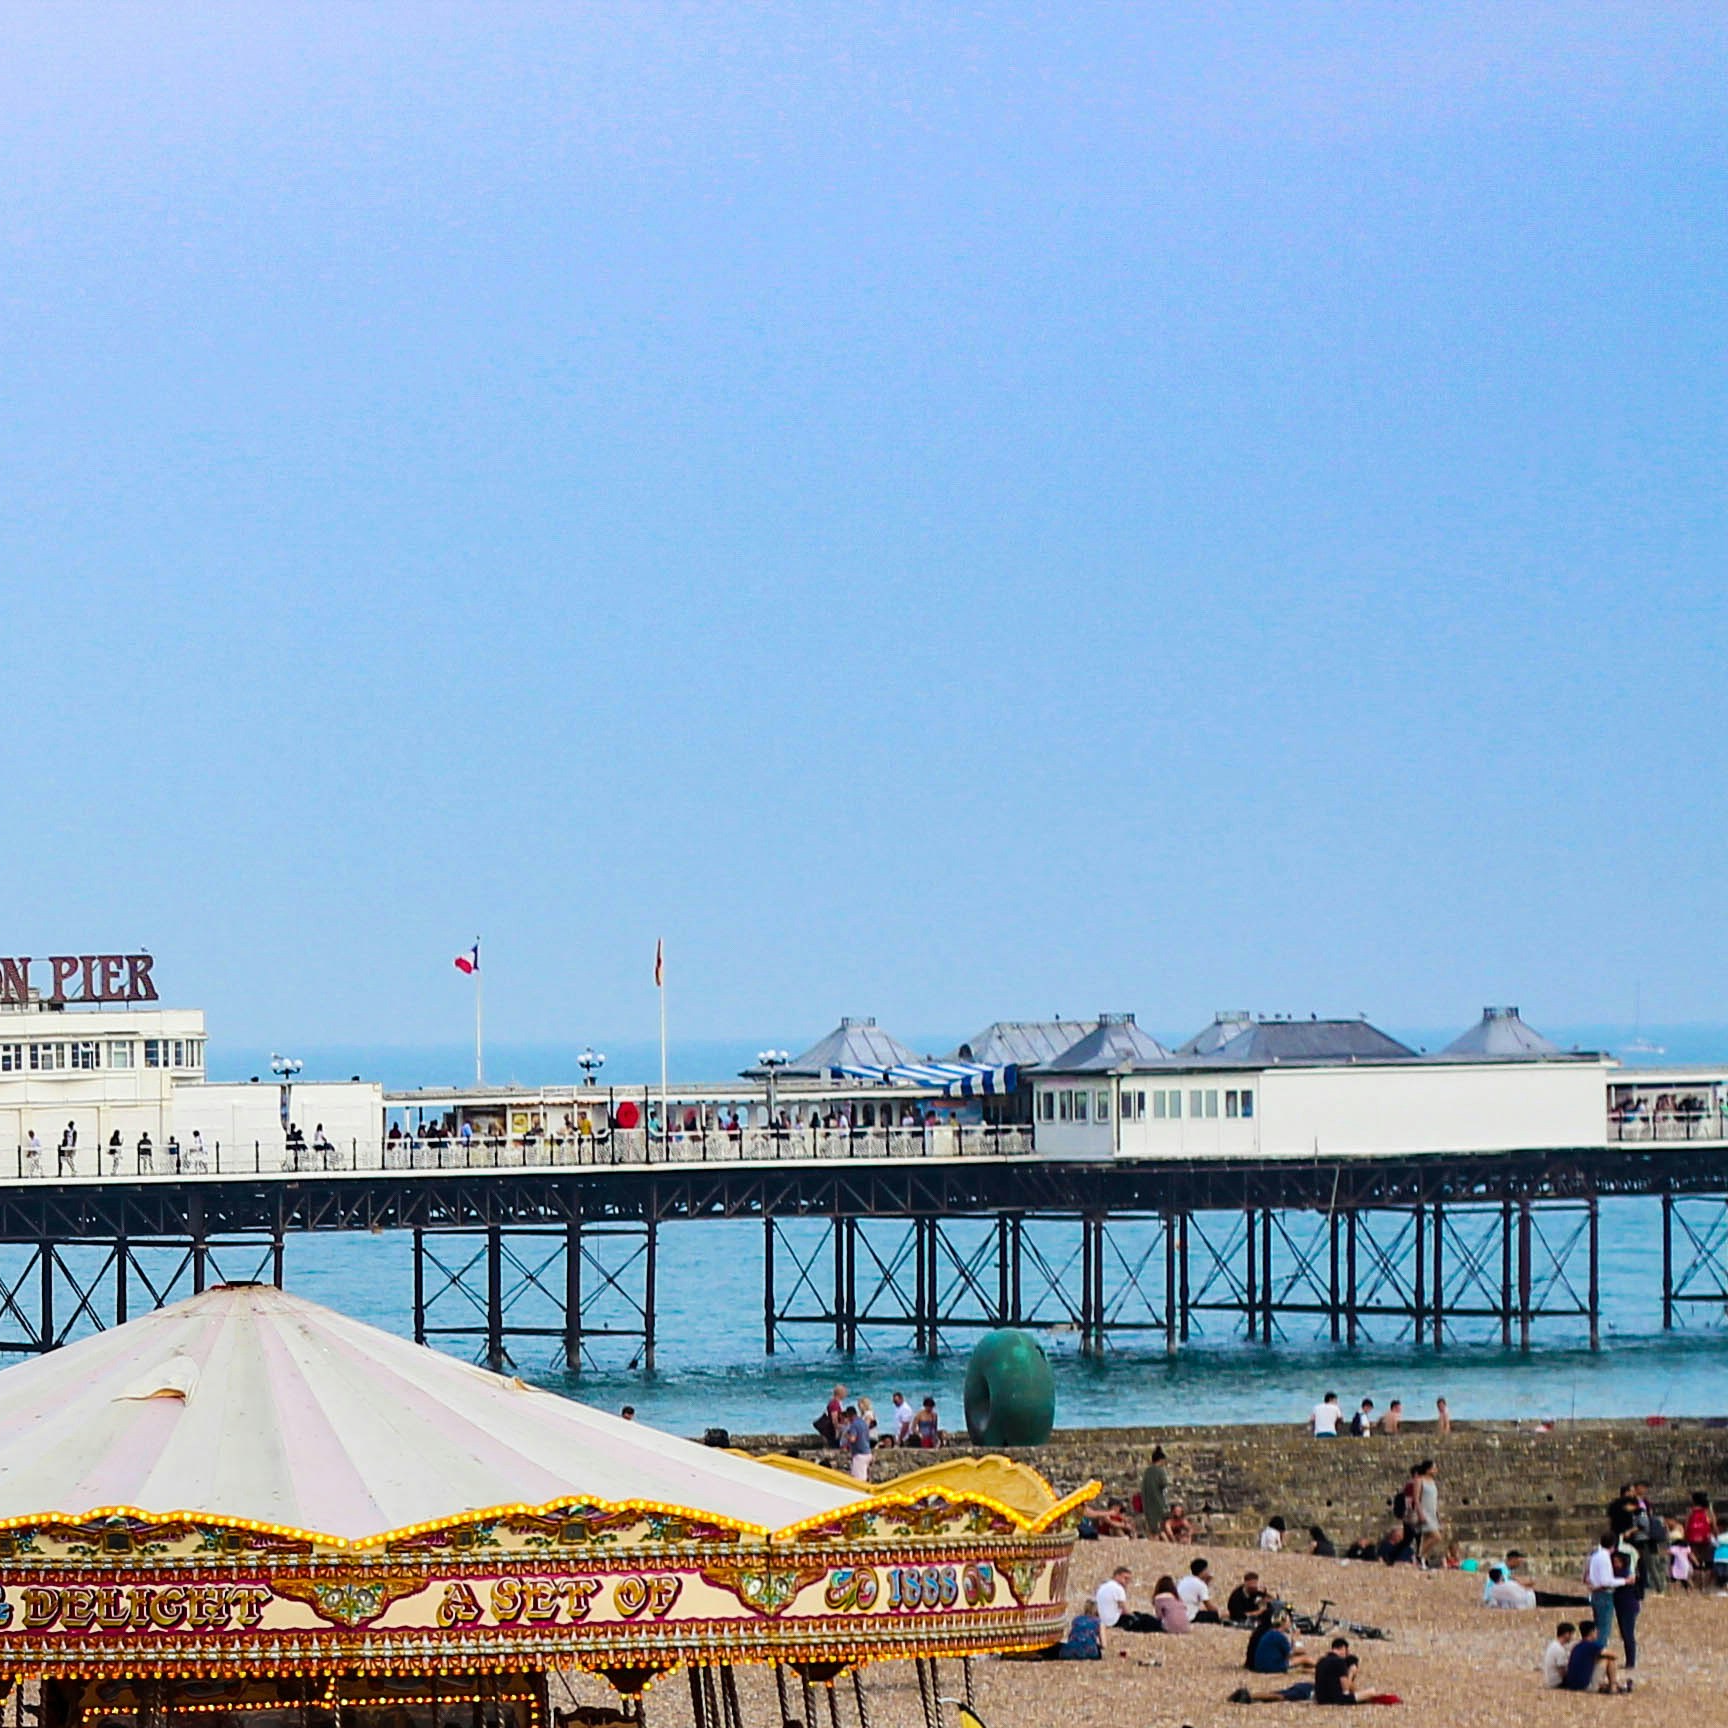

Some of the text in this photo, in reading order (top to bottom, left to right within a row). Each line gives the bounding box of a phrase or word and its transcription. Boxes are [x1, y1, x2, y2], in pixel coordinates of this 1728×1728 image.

[49, 954, 160, 1001] PIER
[20, 1583, 274, 1629] DELIGHT
[436, 1574, 683, 1628] A SET OF
[887, 1566, 959, 1611] 1888
